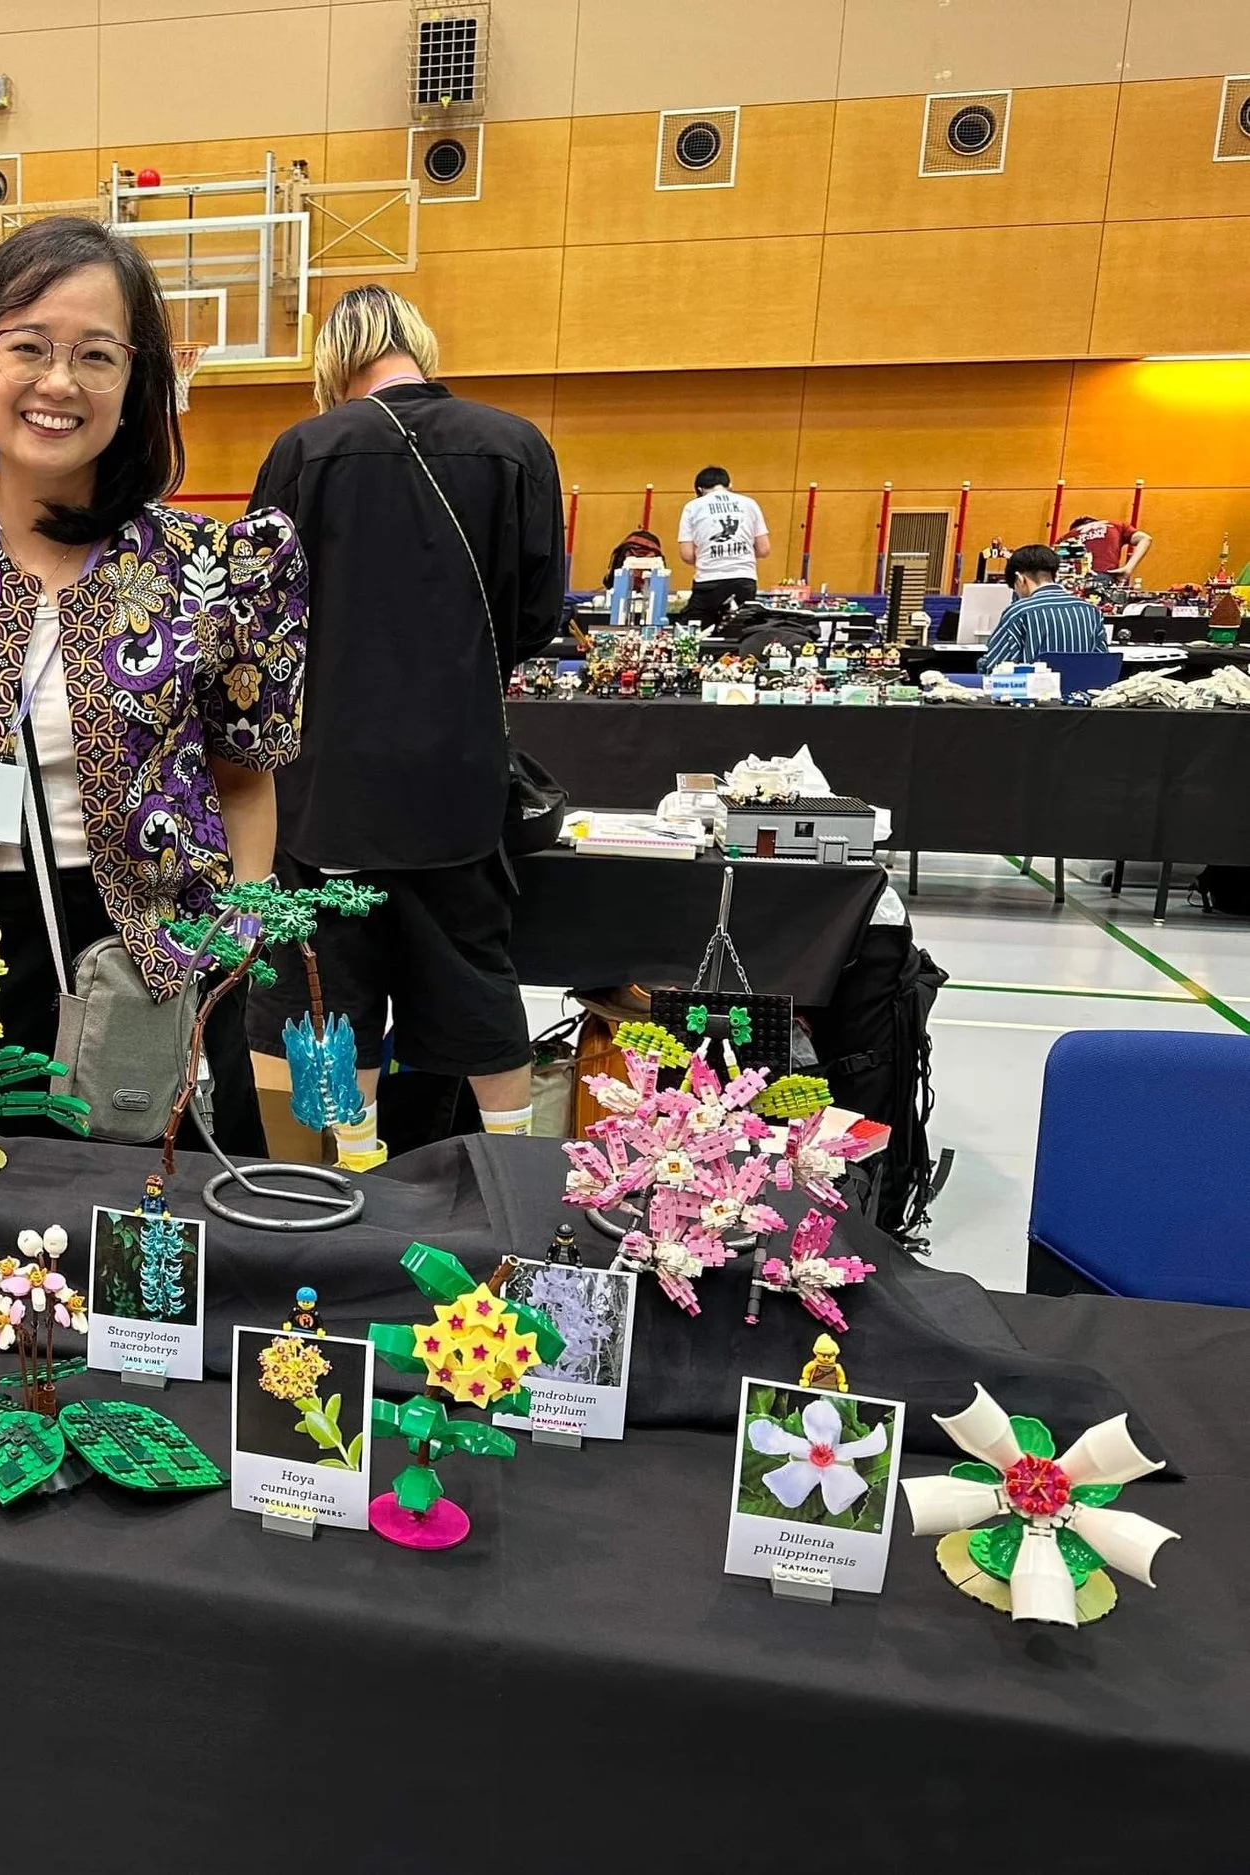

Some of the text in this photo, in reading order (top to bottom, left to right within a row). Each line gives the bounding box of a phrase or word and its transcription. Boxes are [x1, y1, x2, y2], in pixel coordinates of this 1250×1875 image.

[710, 545, 724, 558] NO
[993, 681, 1026, 689] Blue Leaf
[108, 1325, 181, 1343] Strongylodon
[109, 1341, 179, 1356] macrobotrys
[526, 1386, 597, 1404] endrobium
[281, 1470, 315, 1486] Hoya
[260, 1483, 335, 1503] cumingiana
[249, 1494, 347, 1518] "PORCELAIN FLOWERS"
[778, 1530, 835, 1549] Dillenia
[753, 1543, 857, 1567] philippinensis
[776, 1562, 829, 1575] "KATMON"
